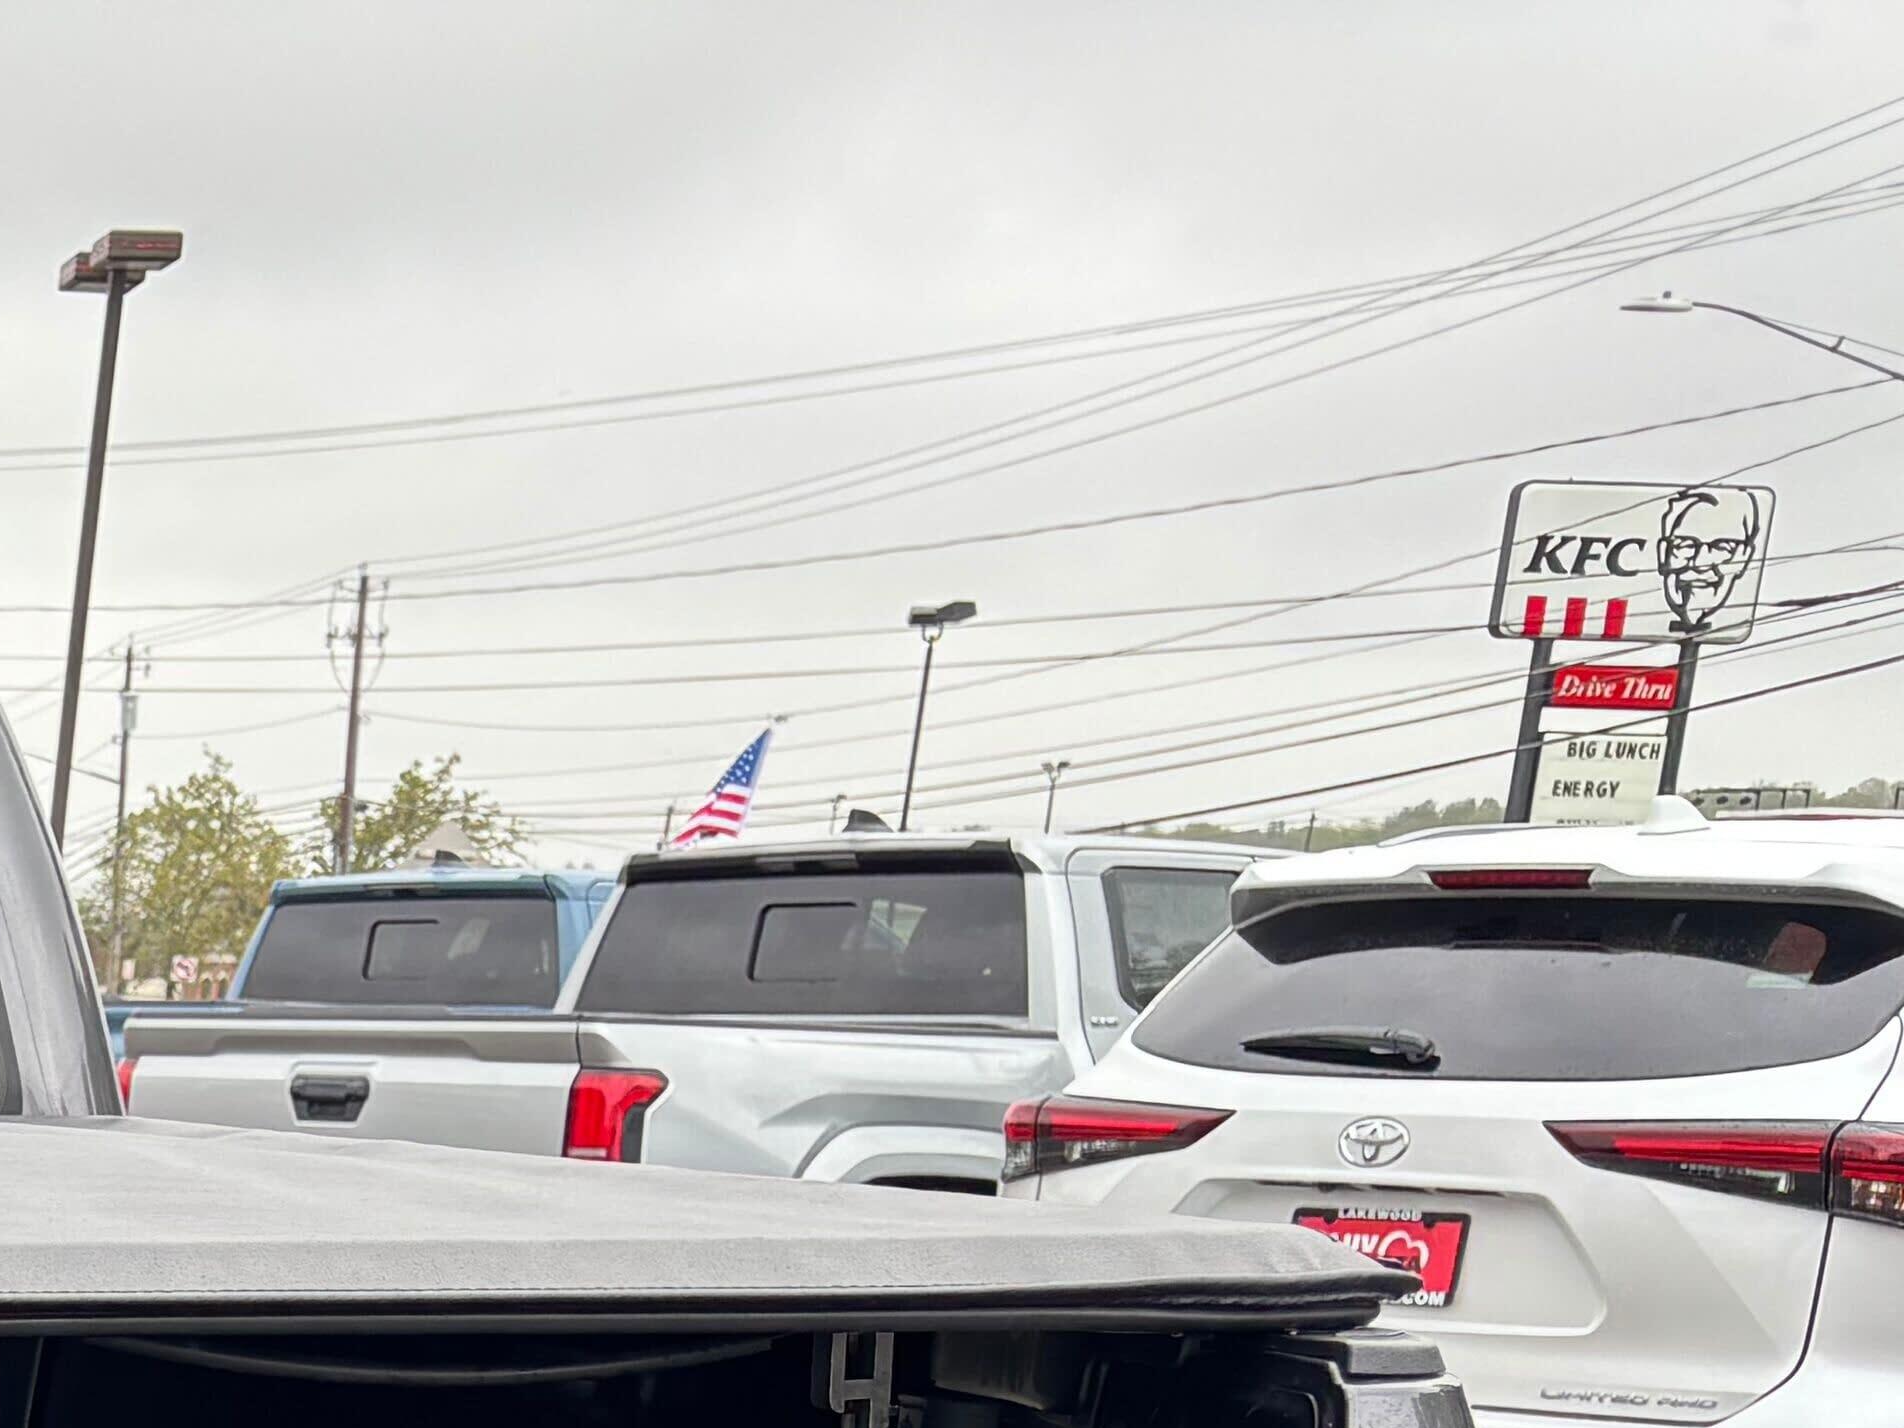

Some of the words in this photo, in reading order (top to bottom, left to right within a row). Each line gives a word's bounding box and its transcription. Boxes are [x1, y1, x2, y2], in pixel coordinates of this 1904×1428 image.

[1523, 535, 1647, 577] KFC
[1557, 673, 1615, 700] Drive
[1623, 675, 1674, 702] Thru
[1566, 741, 1597, 760] BIG
[1603, 741, 1661, 761] LUNCH
[1551, 779, 1620, 799] ENERGY
[1337, 1207, 1423, 1223] LAKEWOOD
[1540, 1387, 1650, 1407] LIMITED
